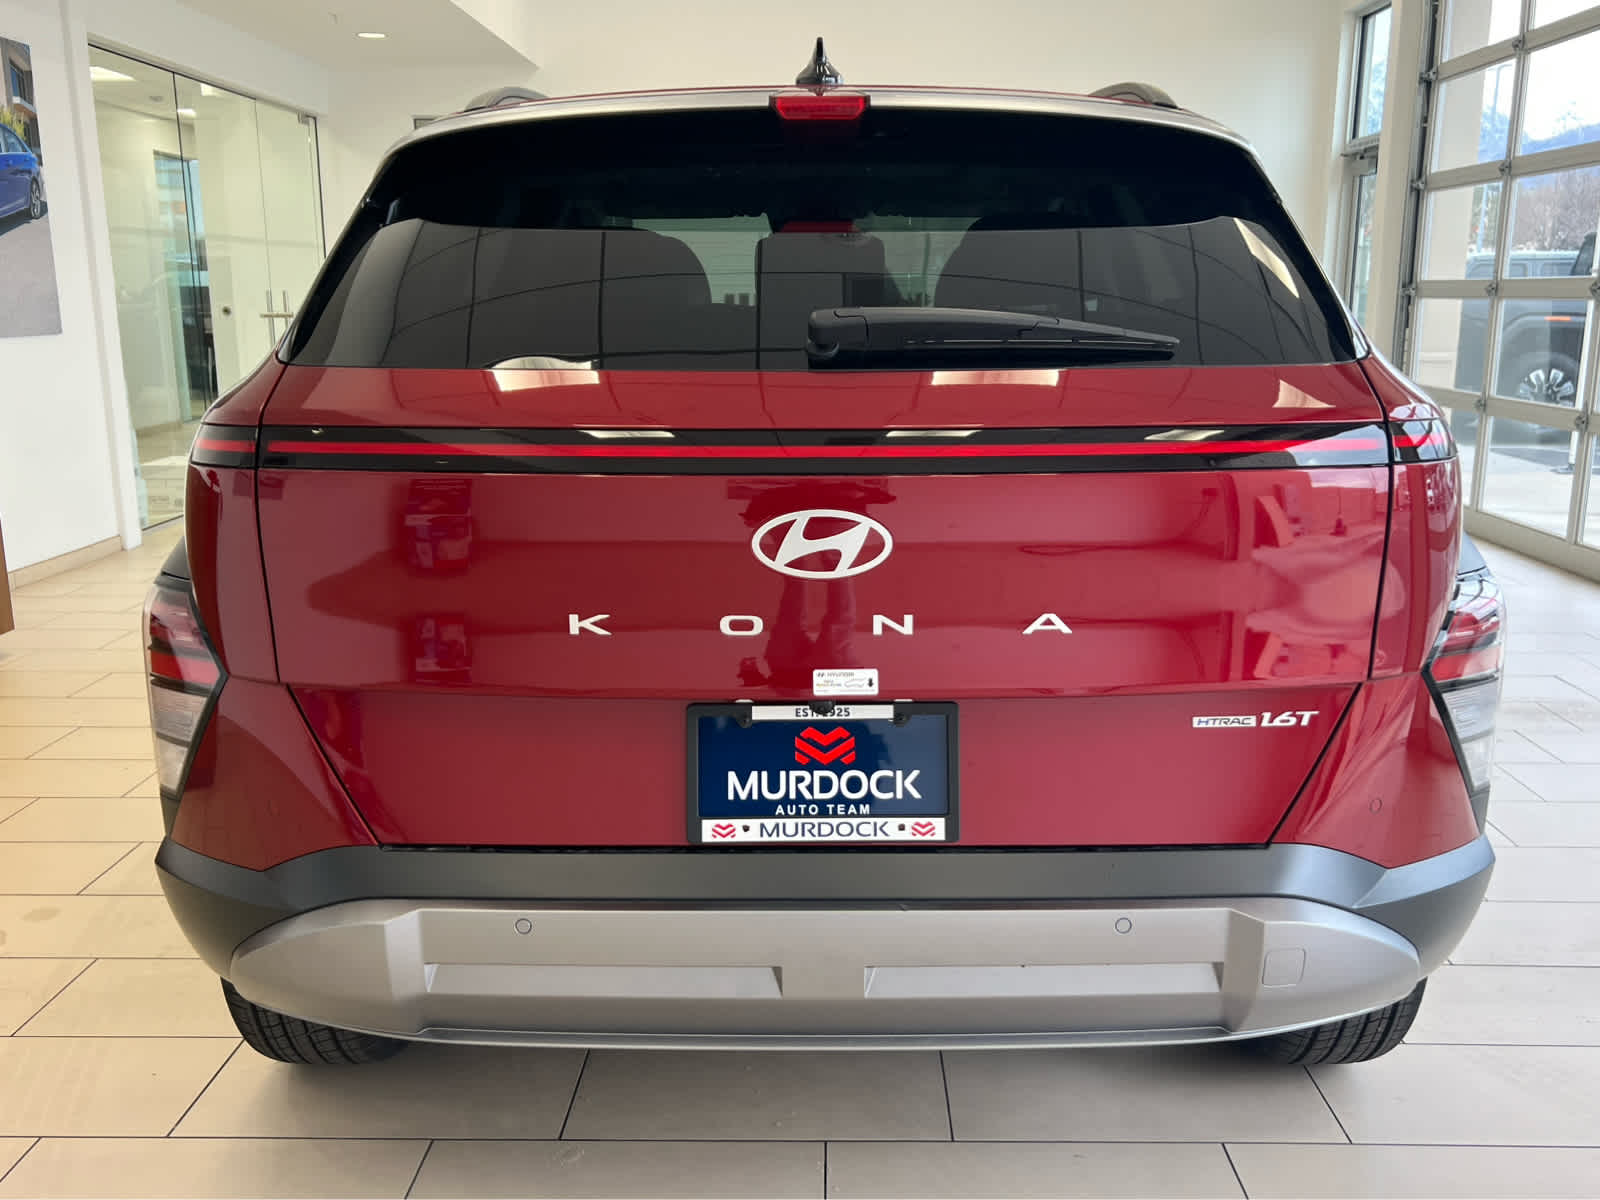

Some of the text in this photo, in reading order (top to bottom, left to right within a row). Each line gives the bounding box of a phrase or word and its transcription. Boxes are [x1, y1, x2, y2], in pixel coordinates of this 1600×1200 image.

[568, 613, 1073, 636] KONA
[822, 707, 851, 717] 925
[1197, 717, 1252, 726] HTRAC
[727, 769, 922, 801] MURDOCK
[775, 804, 870, 816] AUTO TEAM
[759, 821, 889, 838] MURDOCK
